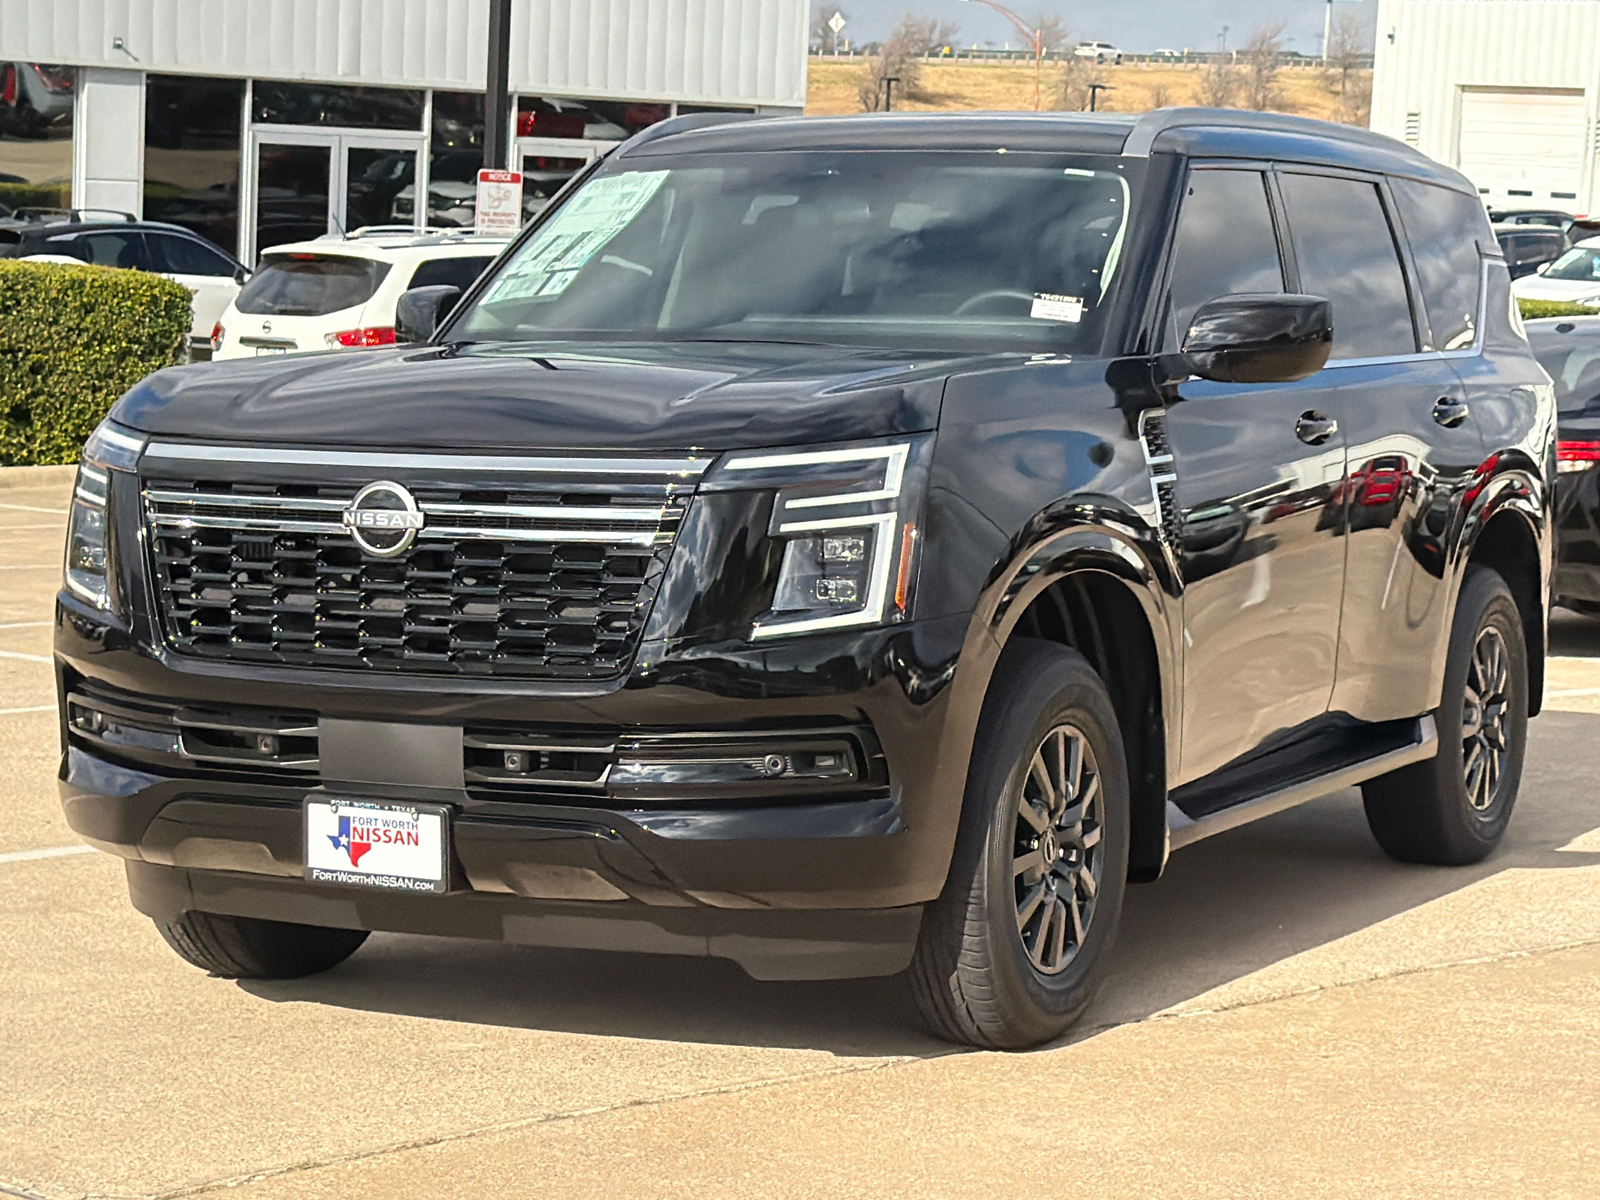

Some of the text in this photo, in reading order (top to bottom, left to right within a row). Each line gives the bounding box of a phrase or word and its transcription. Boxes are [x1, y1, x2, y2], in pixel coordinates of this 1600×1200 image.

[488, 173, 512, 181] NOTICE
[343, 511, 423, 528] NISSAN
[353, 801, 380, 810] WORTH
[352, 816, 419, 831] FORT WORTH
[352, 826, 419, 847] NISSAN
